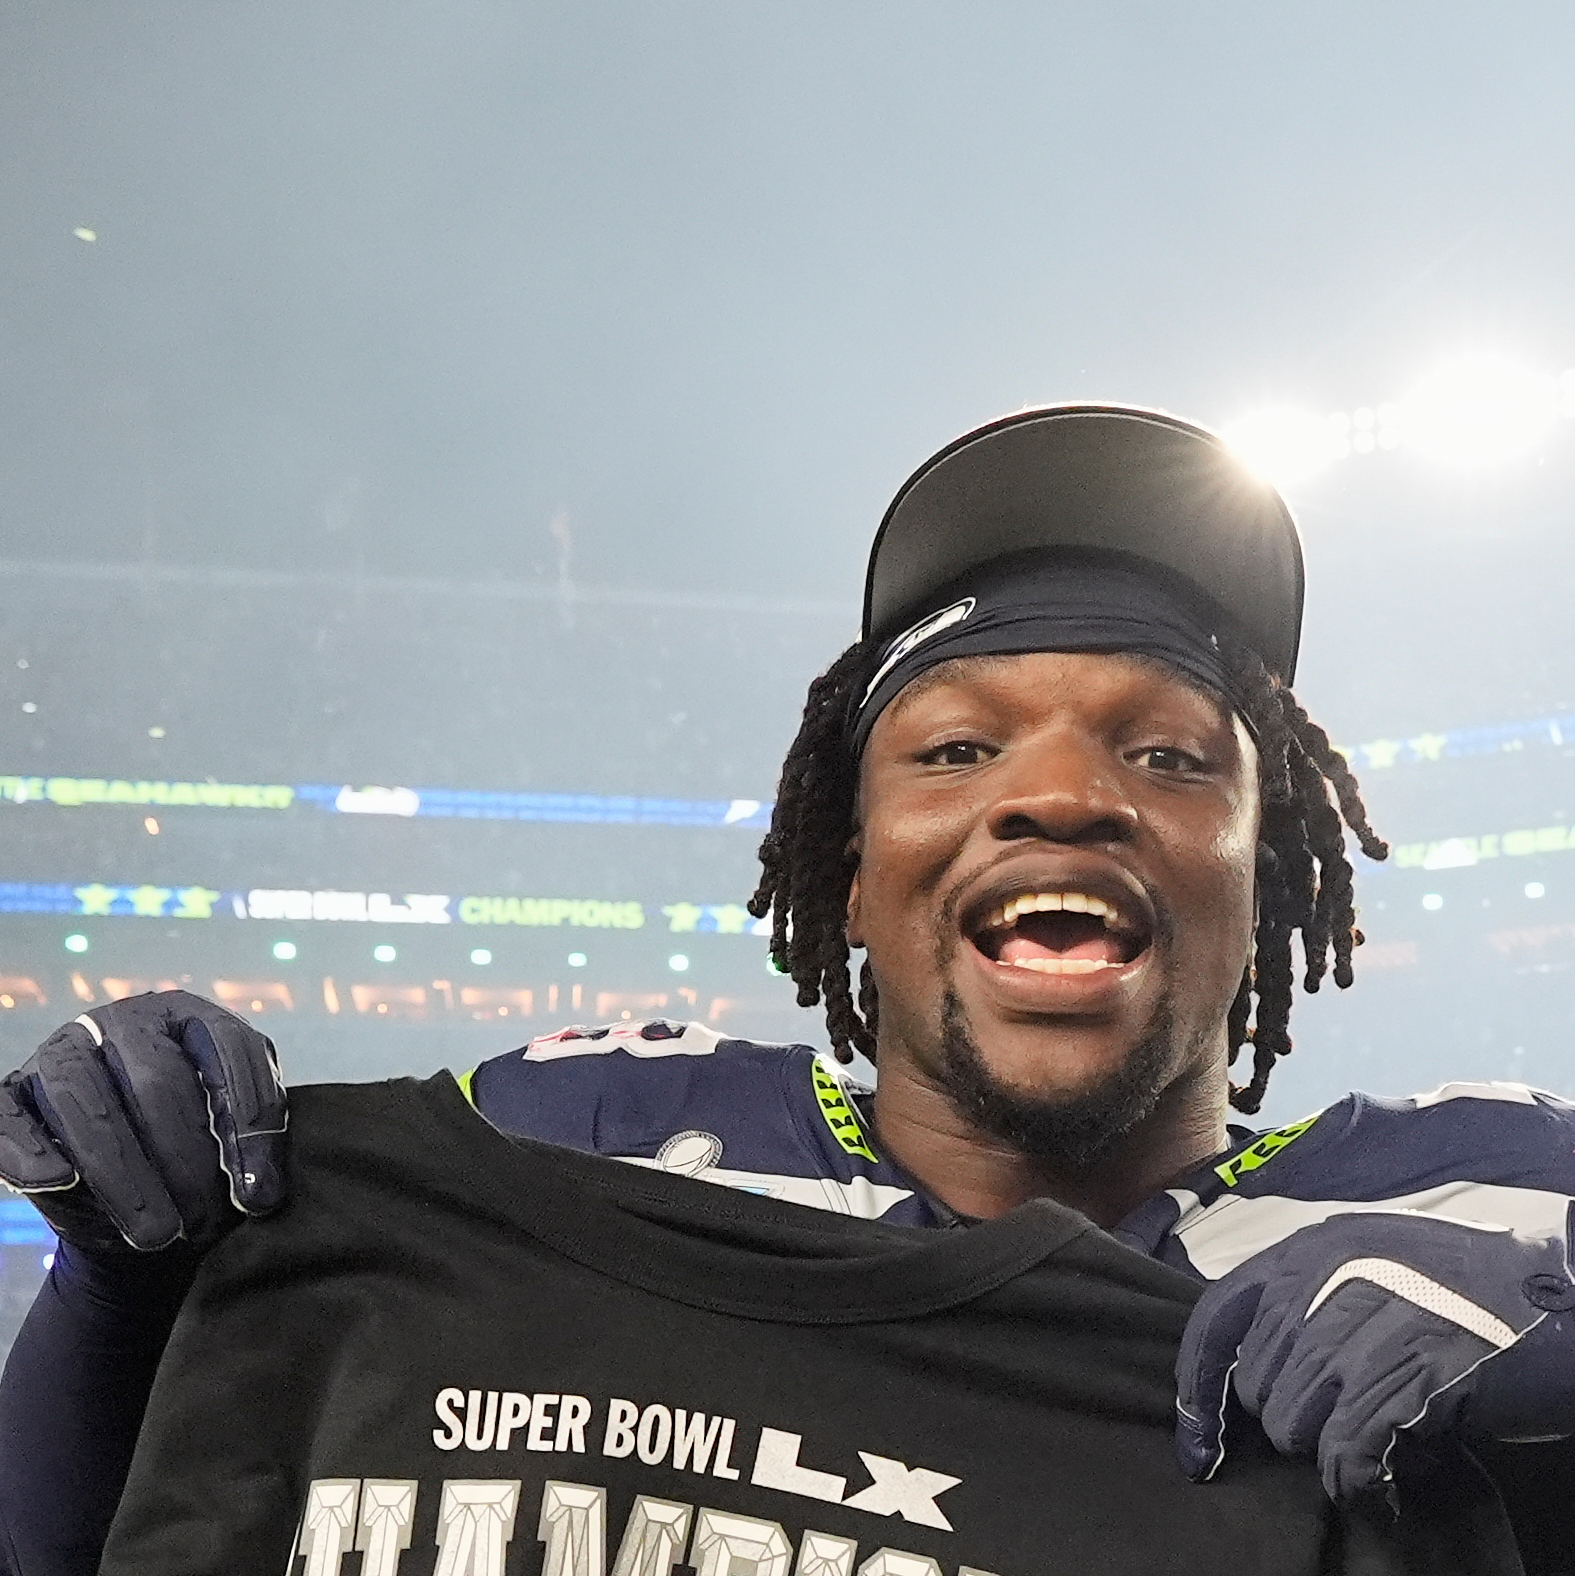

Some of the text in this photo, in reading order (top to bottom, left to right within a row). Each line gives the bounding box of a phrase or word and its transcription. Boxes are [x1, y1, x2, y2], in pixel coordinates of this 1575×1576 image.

[459, 895, 645, 929] CHAMPIONS
[432, 1386, 964, 1532] SUPER BOWL LX
